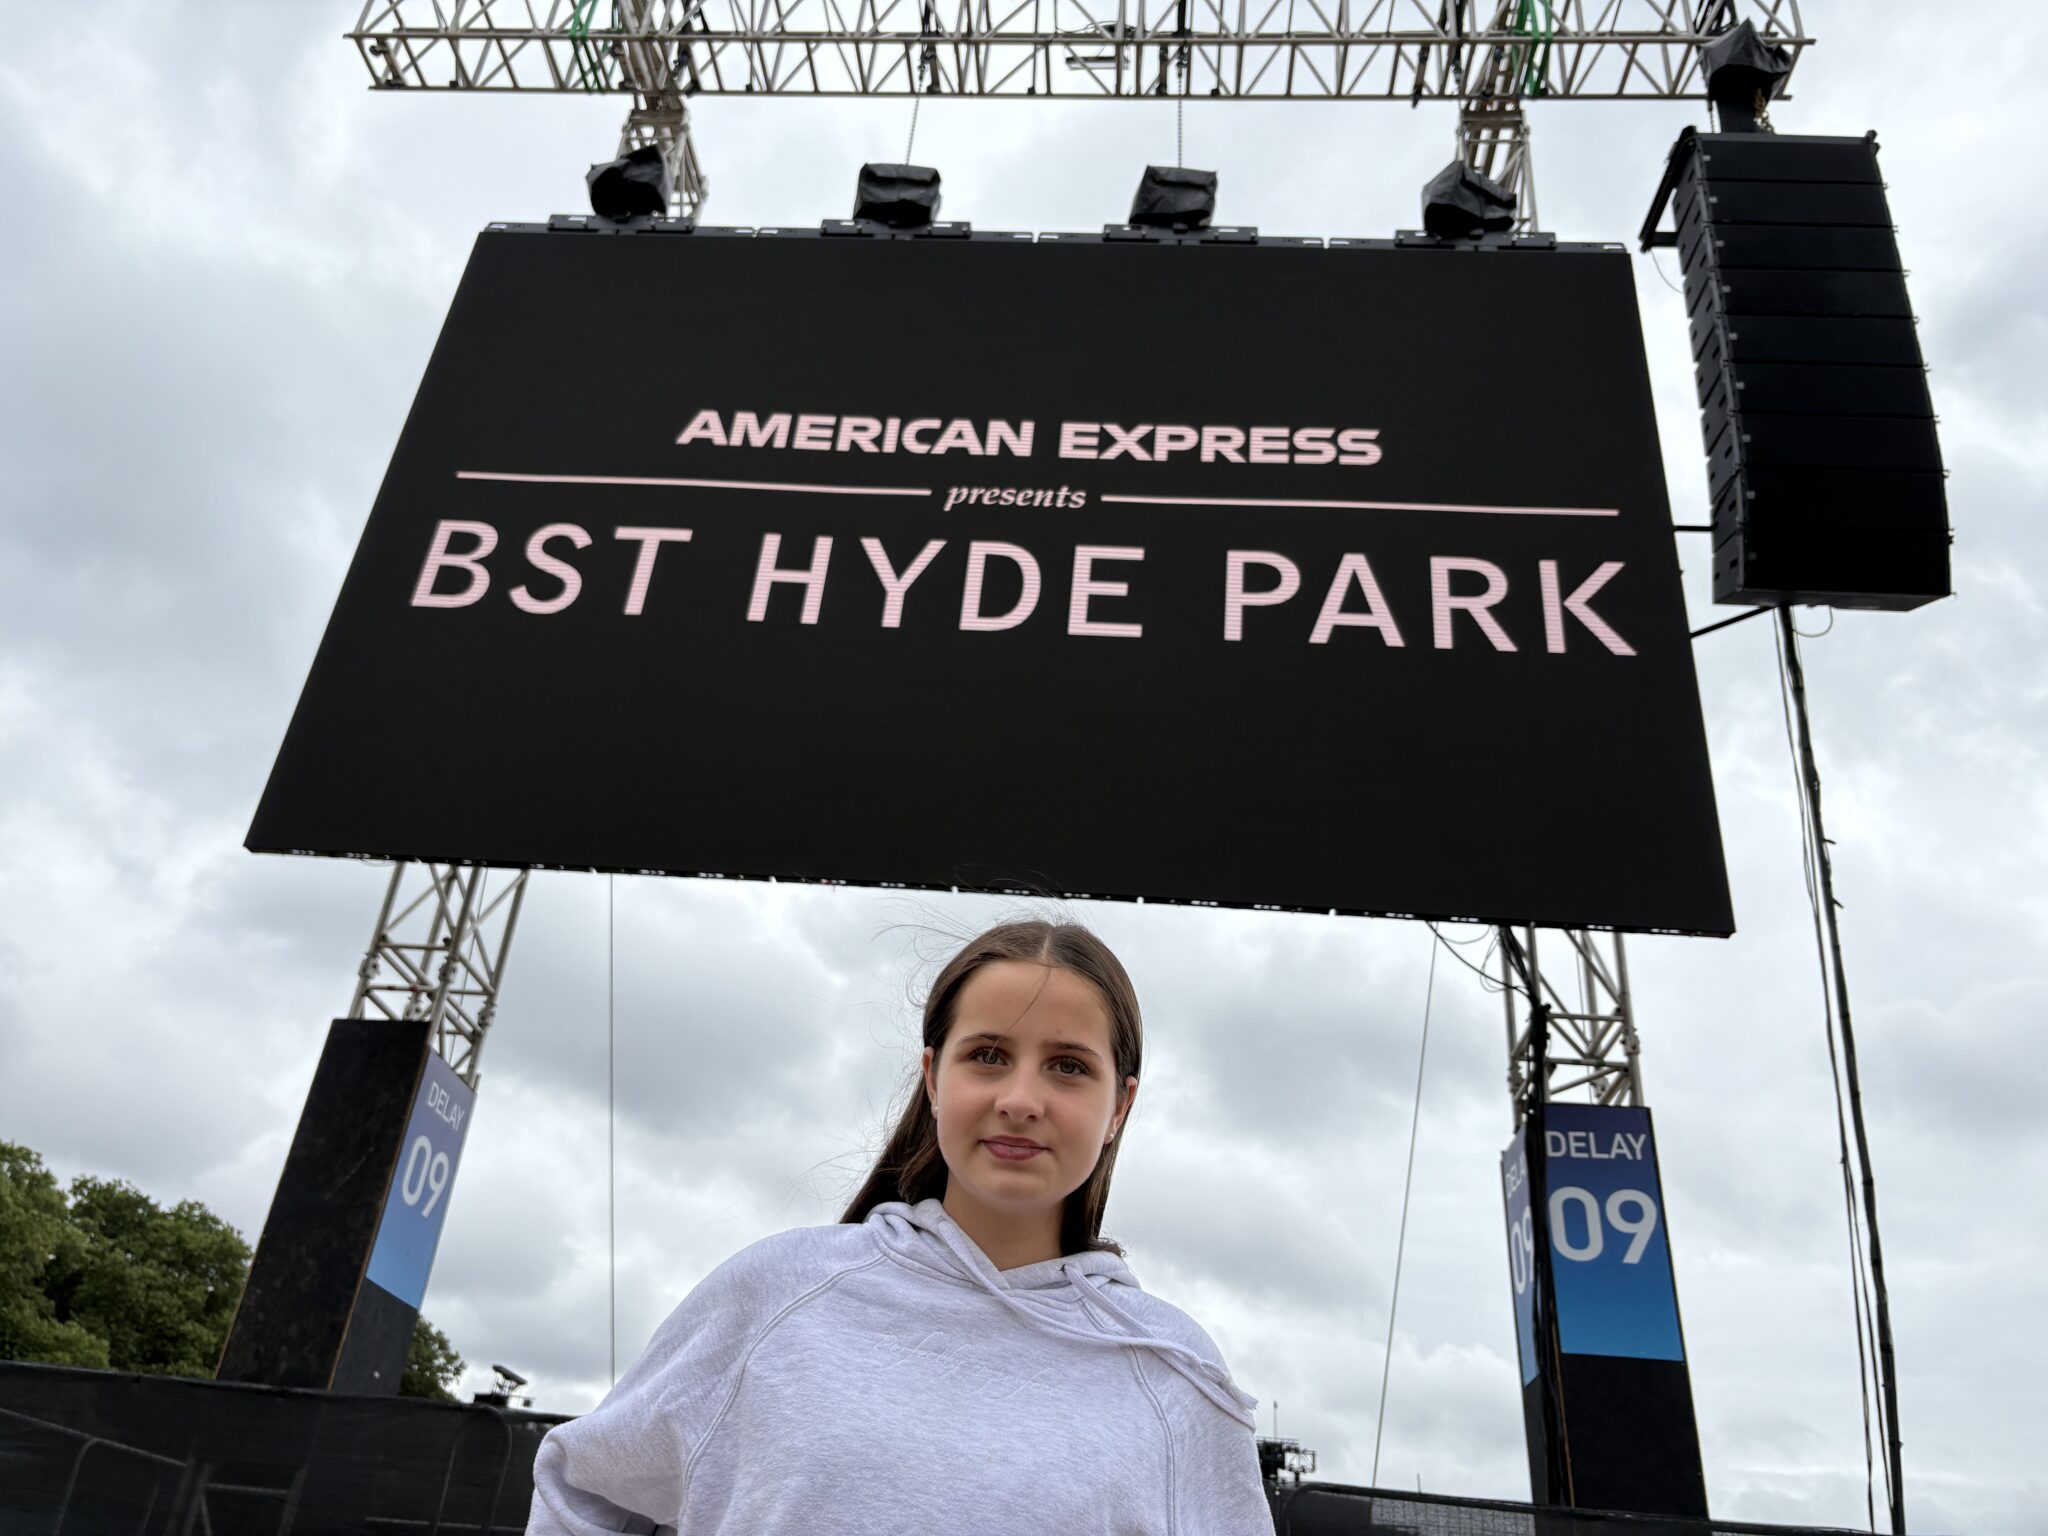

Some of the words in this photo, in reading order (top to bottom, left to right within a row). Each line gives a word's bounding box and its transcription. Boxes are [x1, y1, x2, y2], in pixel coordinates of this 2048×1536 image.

[675, 409, 1036, 457] AMERICAN
[1058, 421, 1383, 466] EXPRESS
[943, 485, 1087, 512] presents
[410, 519, 694, 616] BST
[746, 532, 1146, 638] HYDE
[1223, 549, 1637, 656] PARK
[427, 1081, 465, 1132] DELAY
[1546, 1130, 1647, 1161] DELAY
[402, 1135, 449, 1219] 09
[1506, 1151, 1528, 1199] DELA
[1511, 1205, 1535, 1295] 09
[1549, 1186, 1658, 1265] 09
